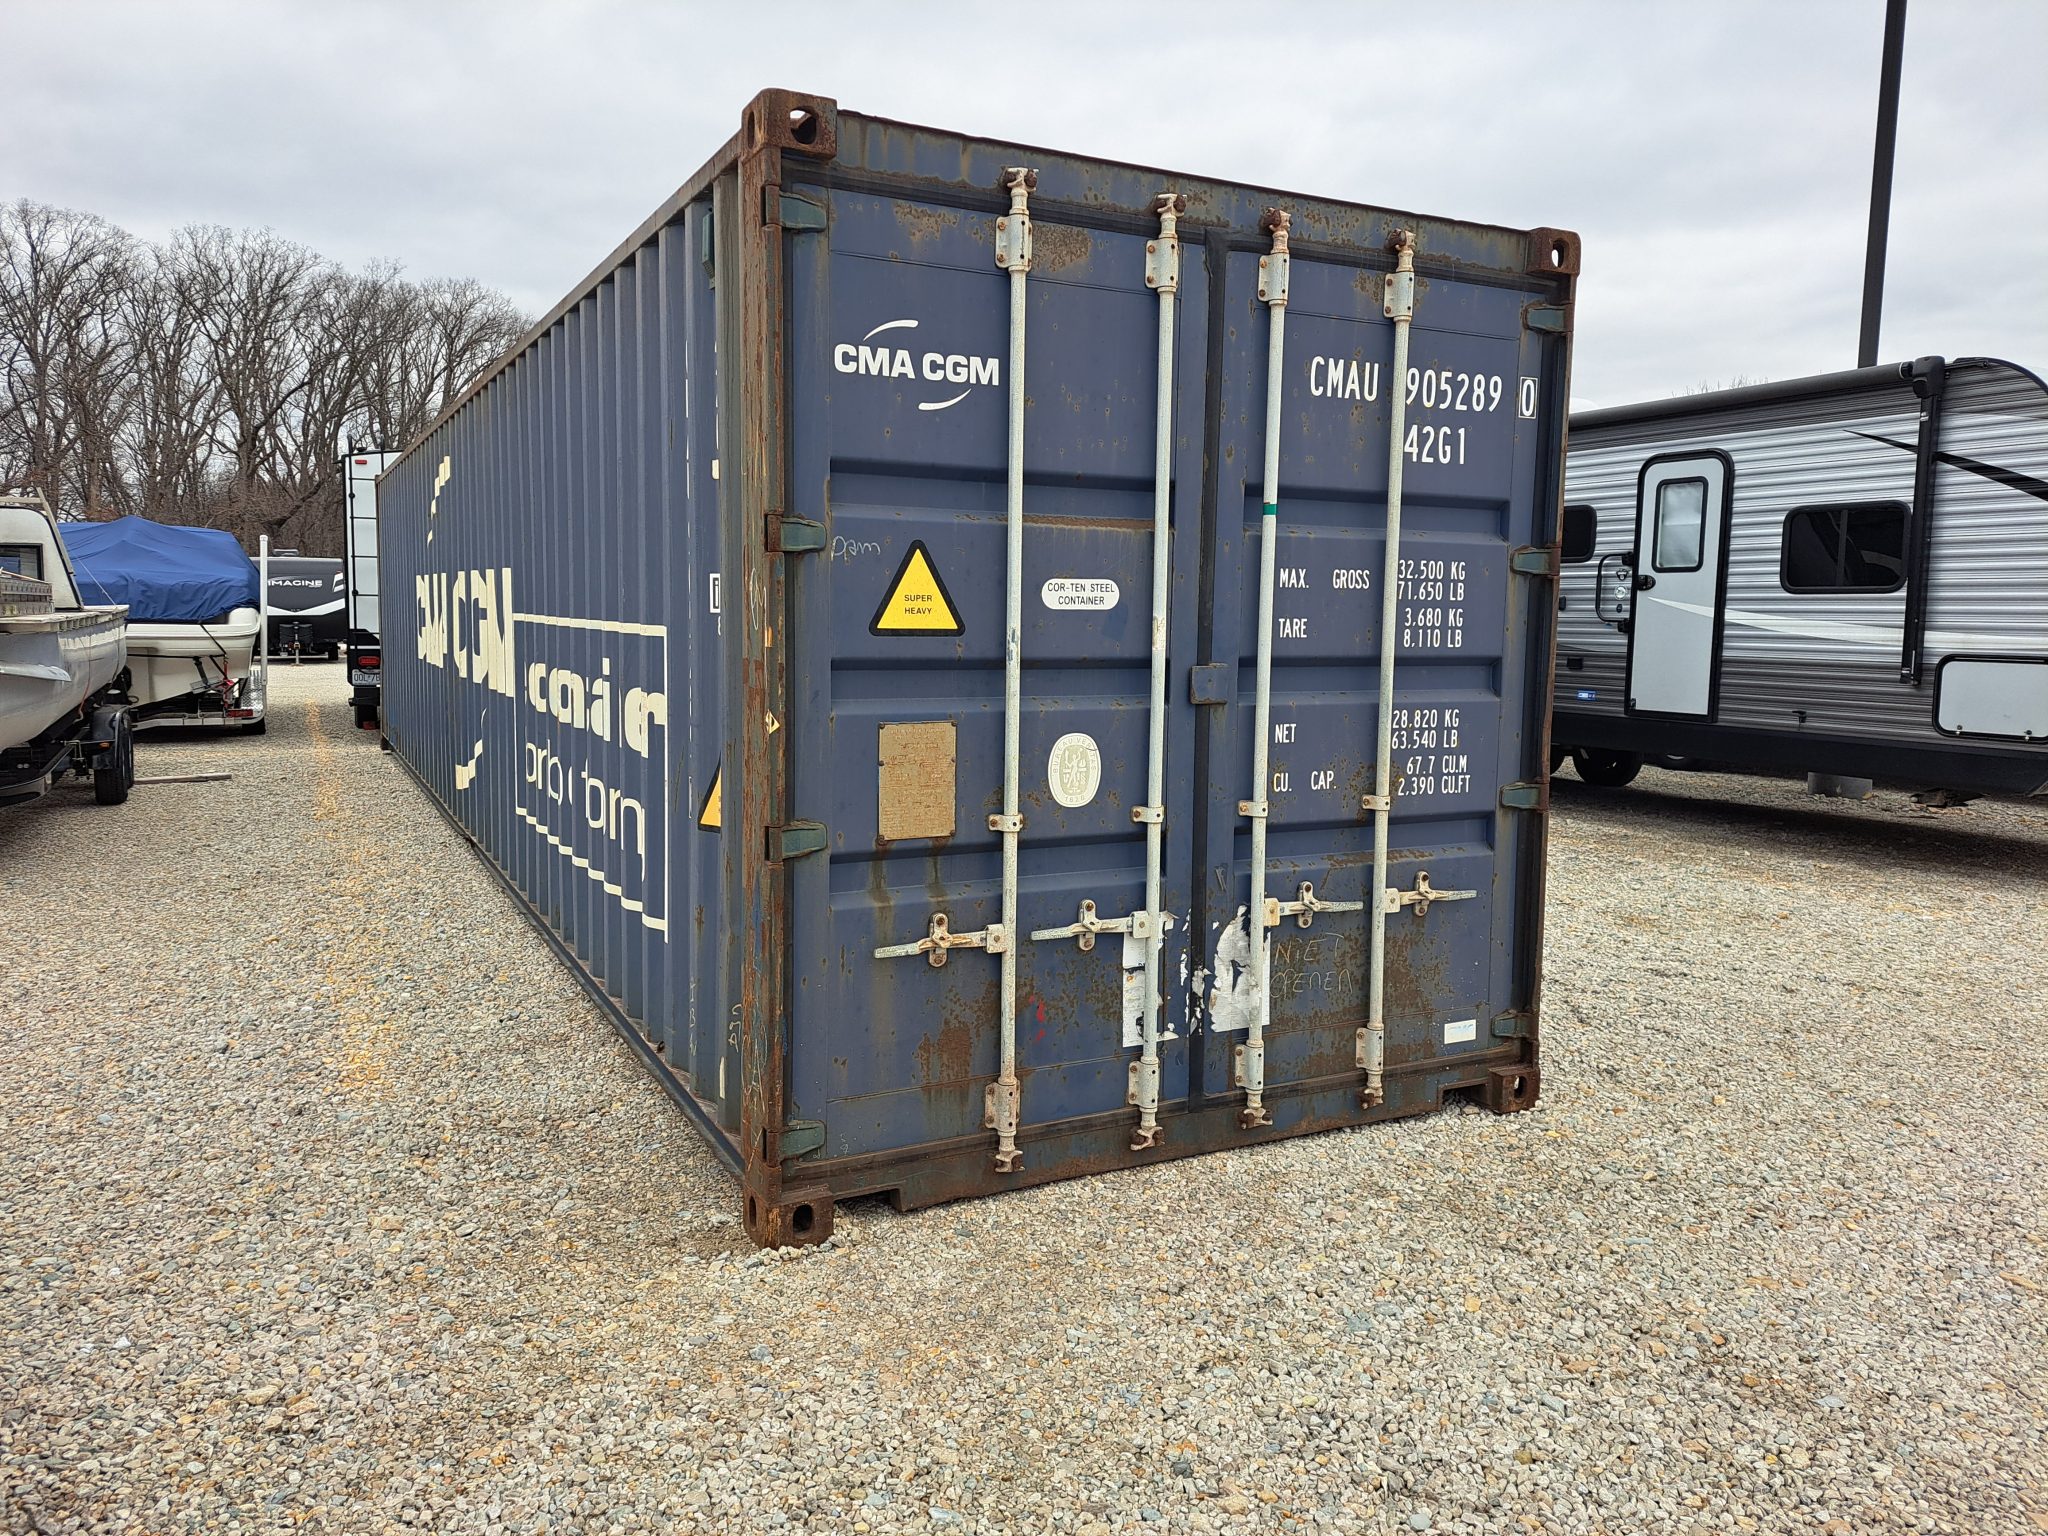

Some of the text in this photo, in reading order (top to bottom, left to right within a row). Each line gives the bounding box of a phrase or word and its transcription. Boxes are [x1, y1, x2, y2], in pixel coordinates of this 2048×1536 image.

[834, 343, 999, 386] CMA CGM
[1310, 355, 1535, 417] CMAU 905289 0
[1404, 424, 1466, 465] 42G1
[267, 579, 323, 587] IMAGINE
[1279, 559, 1466, 590] MAX. GROSS 32,500 KG
[1047, 582, 1115, 593] COR-TEN STEEL
[1398, 582, 1465, 602] 71,650 LB
[904, 594, 933, 603] SUPER
[1058, 595, 1105, 606] CONTAINER
[904, 606, 933, 616] HEAVY
[1279, 607, 1464, 638] TARE 3,680 KG
[1403, 629, 1462, 649] 8,110 LB
[1275, 709, 1459, 743] NET 28,820 KG
[1391, 729, 1458, 750] 63,540 LB
[1273, 755, 1467, 792] CU. CAP. 67.7 CU.M
[1398, 774, 1471, 796] 2,390 CU.FT
